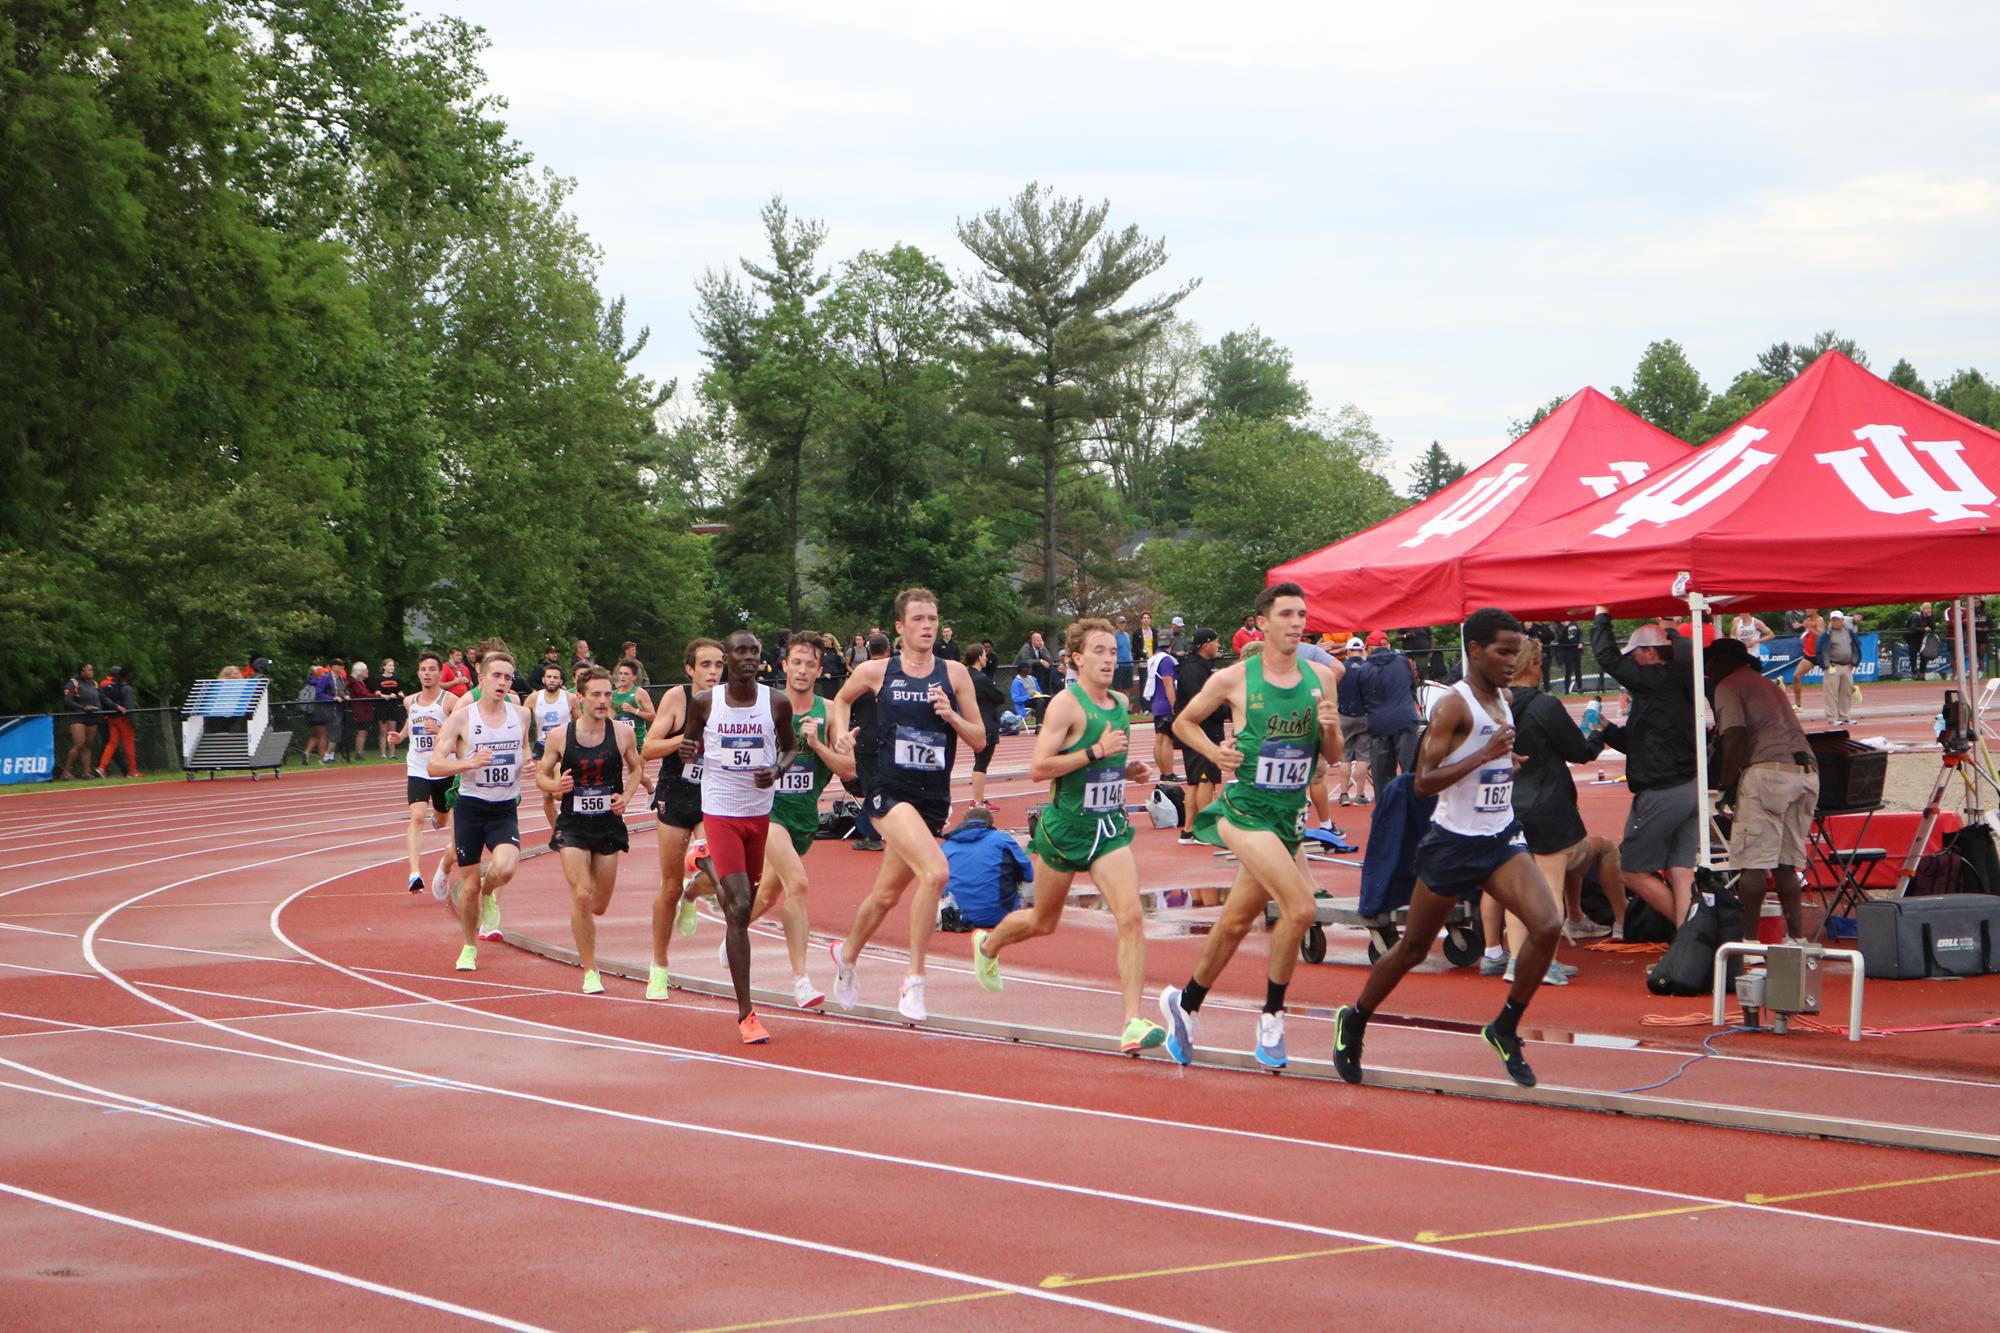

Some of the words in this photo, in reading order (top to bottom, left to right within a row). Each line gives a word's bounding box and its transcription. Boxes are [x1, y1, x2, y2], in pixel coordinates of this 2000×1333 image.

[718, 723, 763, 734] ALABAMA
[1267, 708, 1313, 735] Irish
[733, 751, 751, 765] 54
[907, 744, 936, 764] 172
[3, 758, 12, 775] &
[14, 756, 48, 774] FIELD
[579, 758, 606, 786] H
[1265, 762, 1308, 783] 1142
[483, 767, 509, 783] 188
[780, 774, 810, 789] 1139
[581, 797, 604, 810] 556
[1091, 784, 1123, 806] 1146
[1936, 938, 1958, 947] GILL
